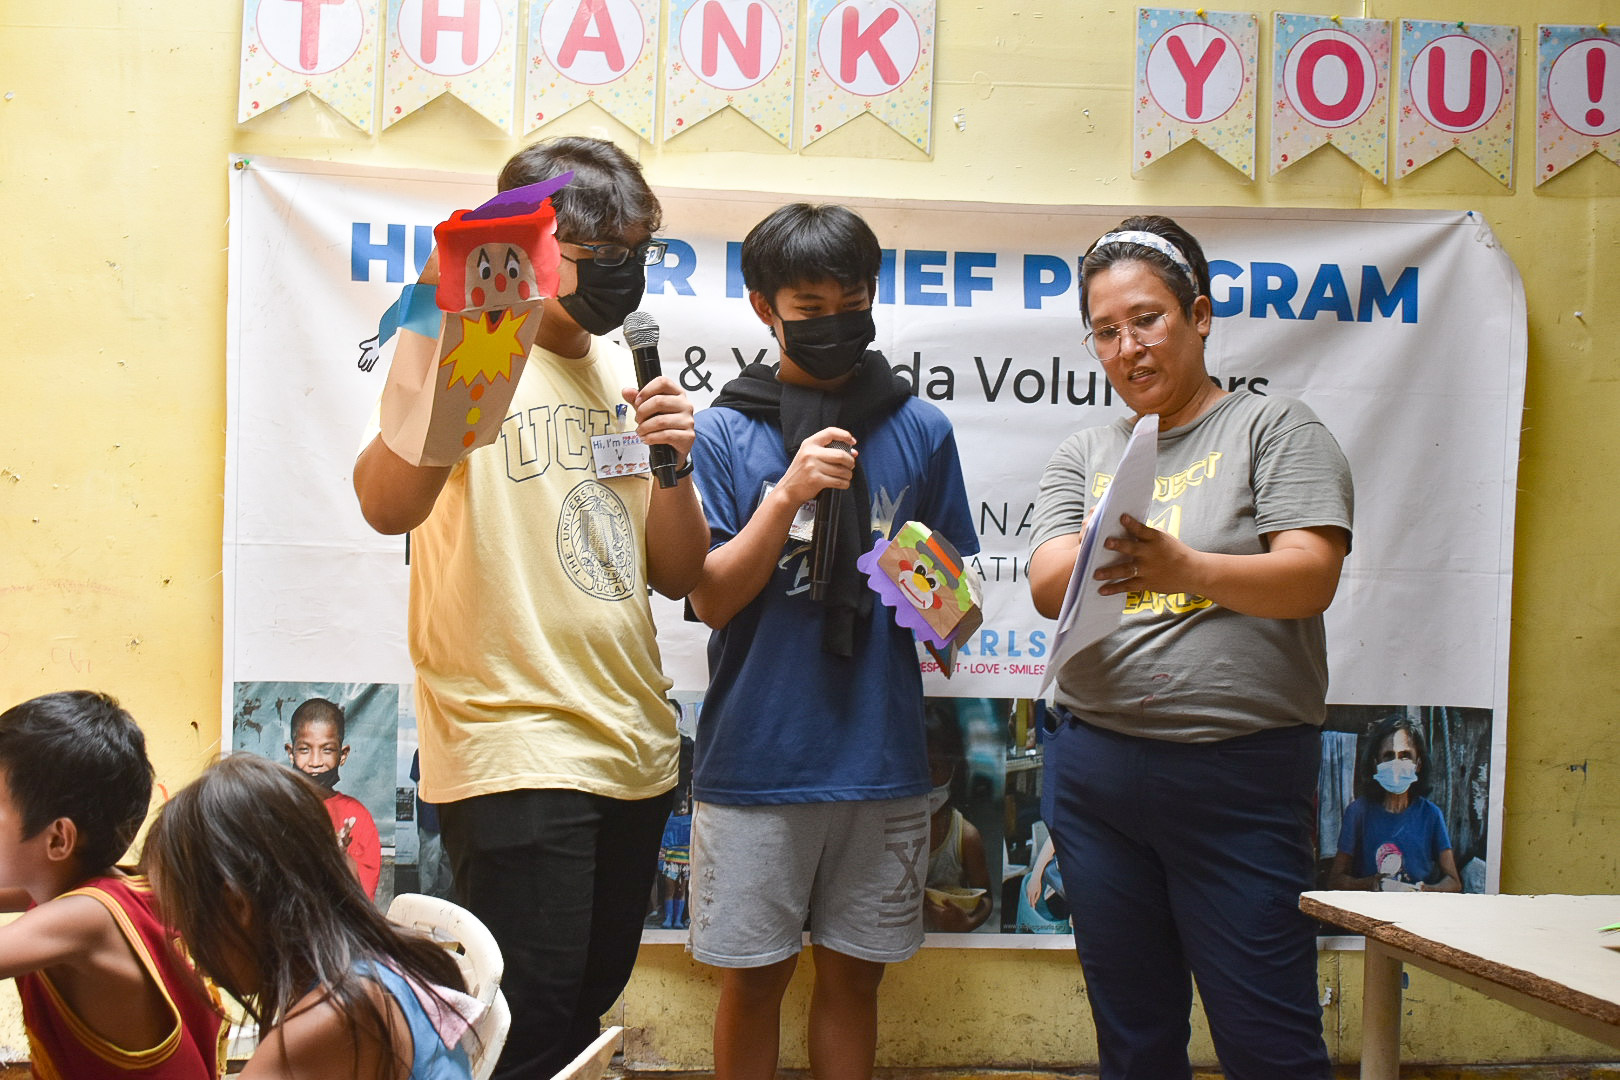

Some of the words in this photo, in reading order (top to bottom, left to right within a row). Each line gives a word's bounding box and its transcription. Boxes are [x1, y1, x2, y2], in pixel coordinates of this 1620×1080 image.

[284, 0, 901, 86] THANK
[1024, 254, 1419, 324] PGRAM
[679, 346, 714, 393] &
[592, 440, 605, 450] Hi,
[606, 437, 621, 448] I'm
[1092, 451, 1223, 502] PJECT
[595, 582, 622, 595] UCLA
[969, 663, 1001, 674] LOVE
[1008, 664, 1047, 676] SMILES
